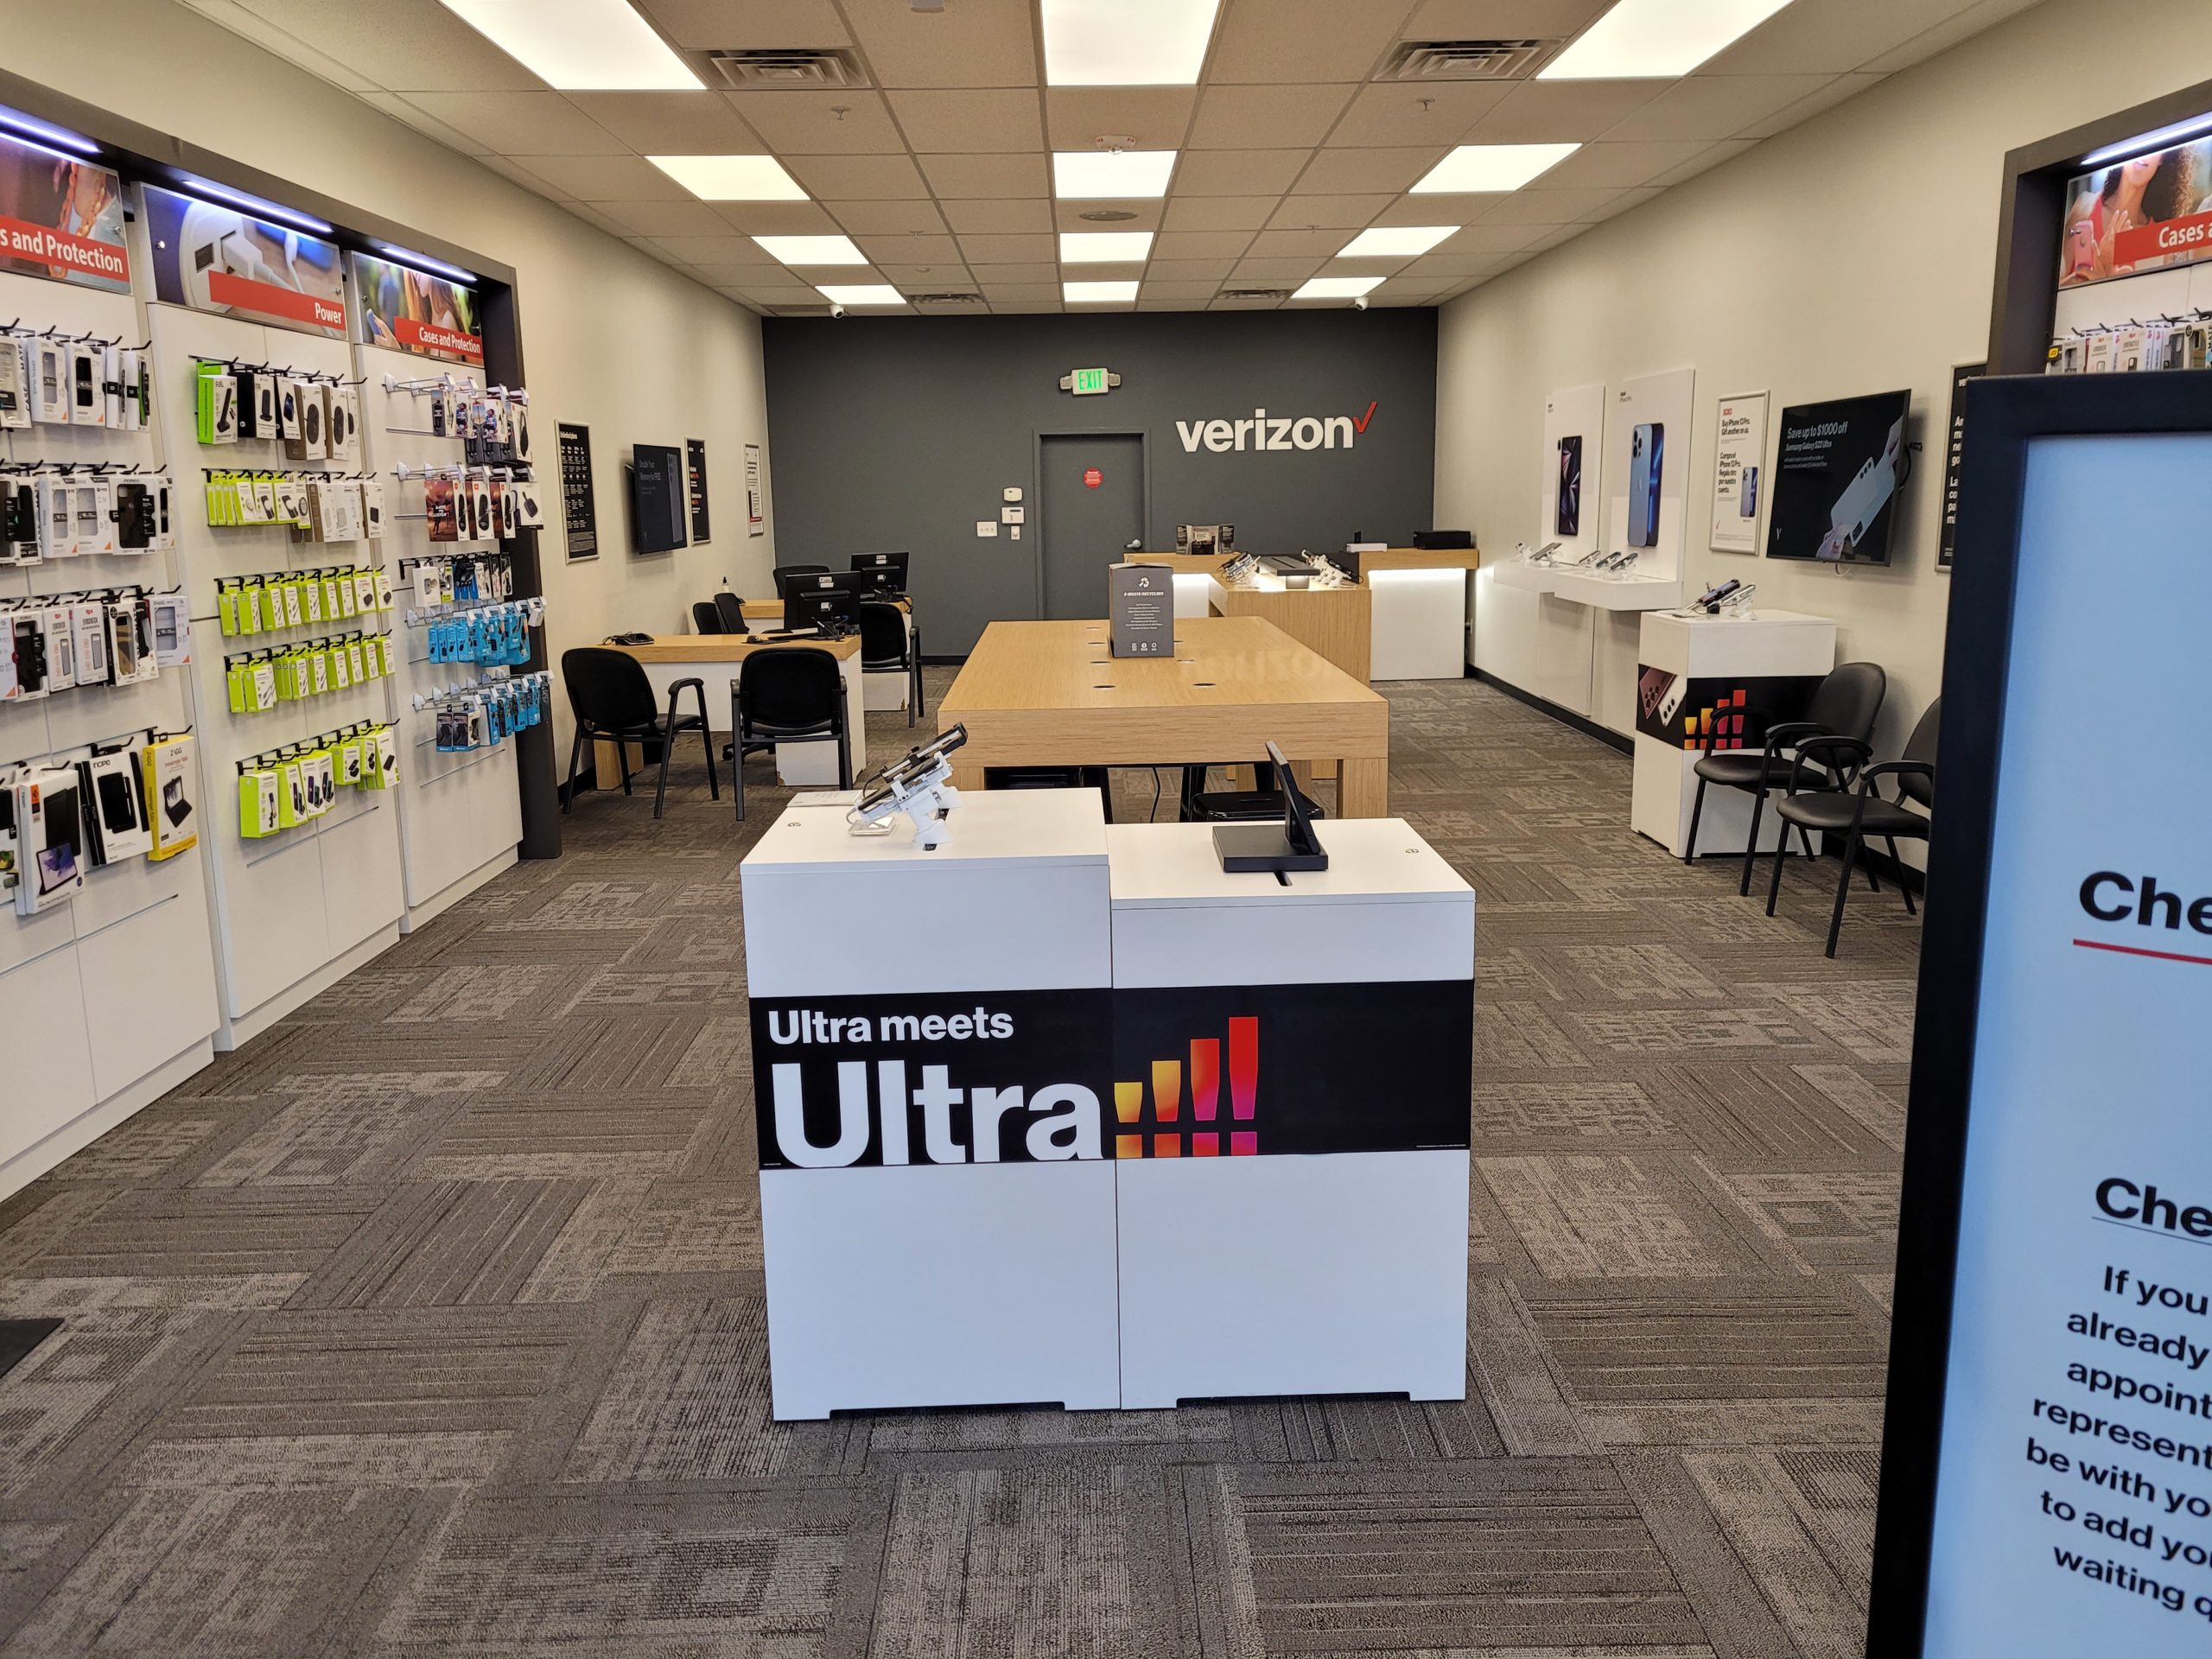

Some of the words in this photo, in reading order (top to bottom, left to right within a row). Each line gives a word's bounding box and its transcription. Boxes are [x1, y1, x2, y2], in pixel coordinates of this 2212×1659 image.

[12, 231, 44, 255] and
[46, 234, 124, 274] Protection
[2158, 224, 2204, 248] Cases
[315, 302, 342, 325] Power
[419, 326, 438, 345] Cases
[438, 332, 451, 346] and
[451, 334, 481, 354] Protection
[1078, 371, 1103, 390] EXIT
[1176, 409, 1353, 452] verizon
[1787, 427, 1802, 439] Save
[1802, 430, 1810, 440] up
[1810, 426, 1816, 437] to
[1817, 422, 1838, 437] $1000
[1838, 421, 1848, 434] off
[768, 1009, 873, 1045] Ultra
[880, 1007, 1014, 1041] meets
[772, 1059, 1104, 1168] Ultra
[2104, 1265, 2130, 1294] If
[2136, 1280, 2208, 1316] you
[2067, 1312, 2209, 1370] already
[2026, 1436, 2070, 1472] be
[2078, 1460, 2156, 1503] with
[2041, 1491, 2076, 1522] to
[2083, 1512, 2153, 1549] add
[2054, 1546, 2185, 1611] waiting
